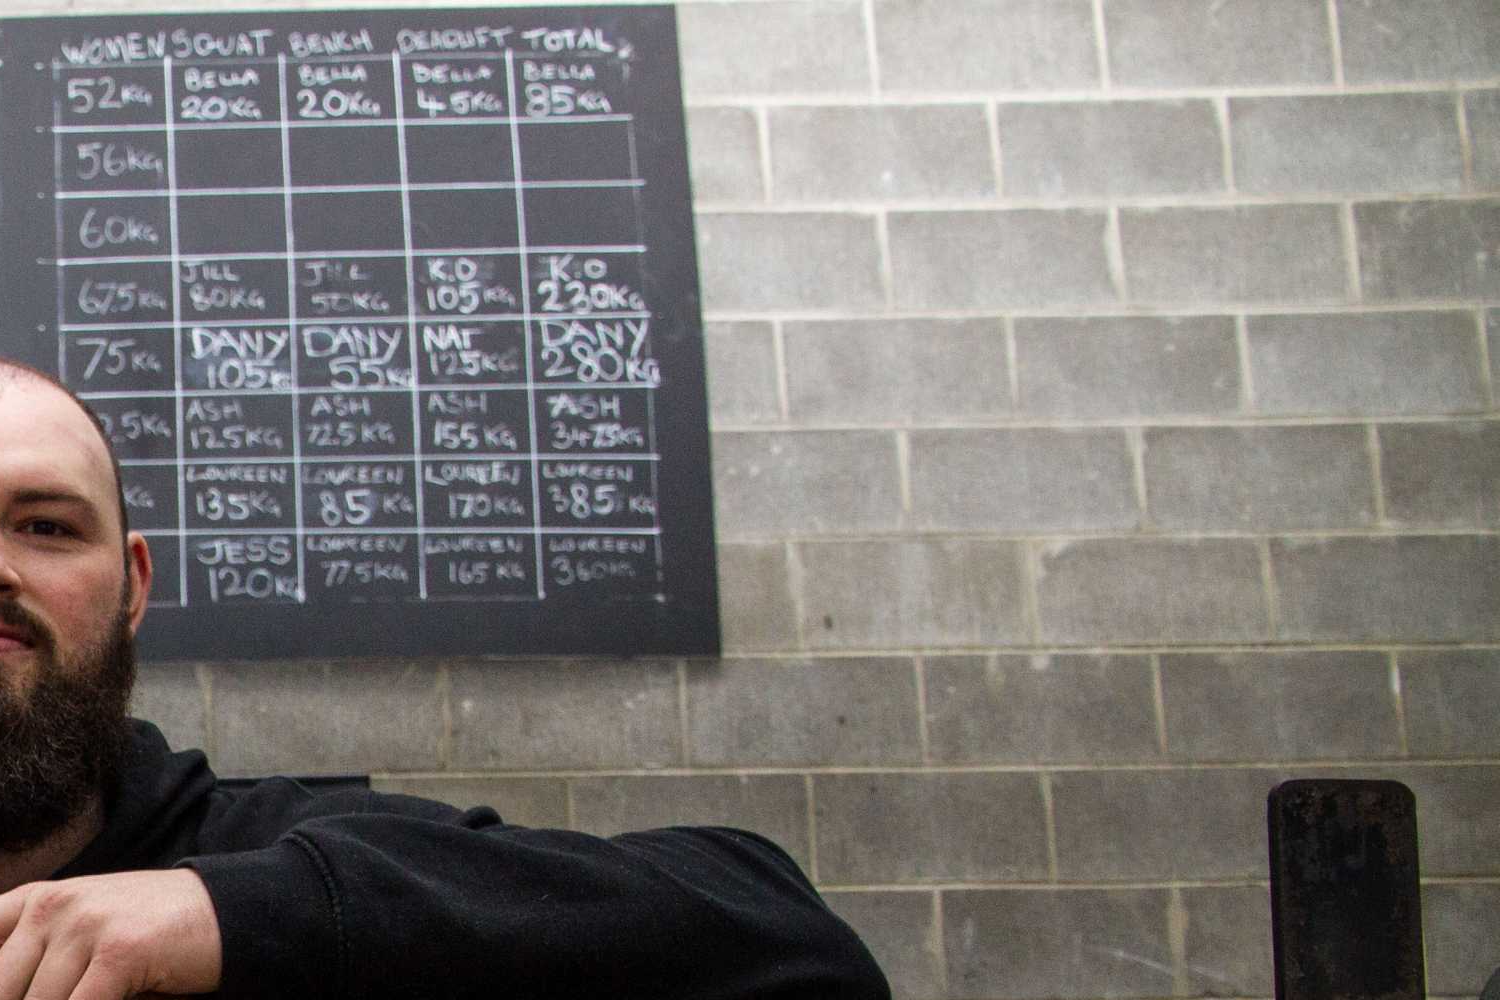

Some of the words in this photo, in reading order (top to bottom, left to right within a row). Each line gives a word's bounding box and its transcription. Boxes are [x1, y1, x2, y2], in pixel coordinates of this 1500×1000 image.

[61, 31, 166, 64] WOMEN
[171, 28, 275, 58] SQUAT
[288, 28, 373, 58] BENCH
[521, 27, 614, 52] TOTAL
[298, 64, 367, 87] BELLA
[523, 60, 595, 81] BELLA
[180, 261, 239, 283] JILL
[192, 328, 288, 360] DANY
[303, 326, 401, 363] DANY
[424, 324, 482, 352] NAT
[540, 318, 648, 359] DANY
[187, 399, 242, 423] ASH
[311, 395, 371, 417] ASH
[428, 392, 487, 415] ASH
[547, 393, 620, 419] ASH
[197, 536, 291, 565] JESS
